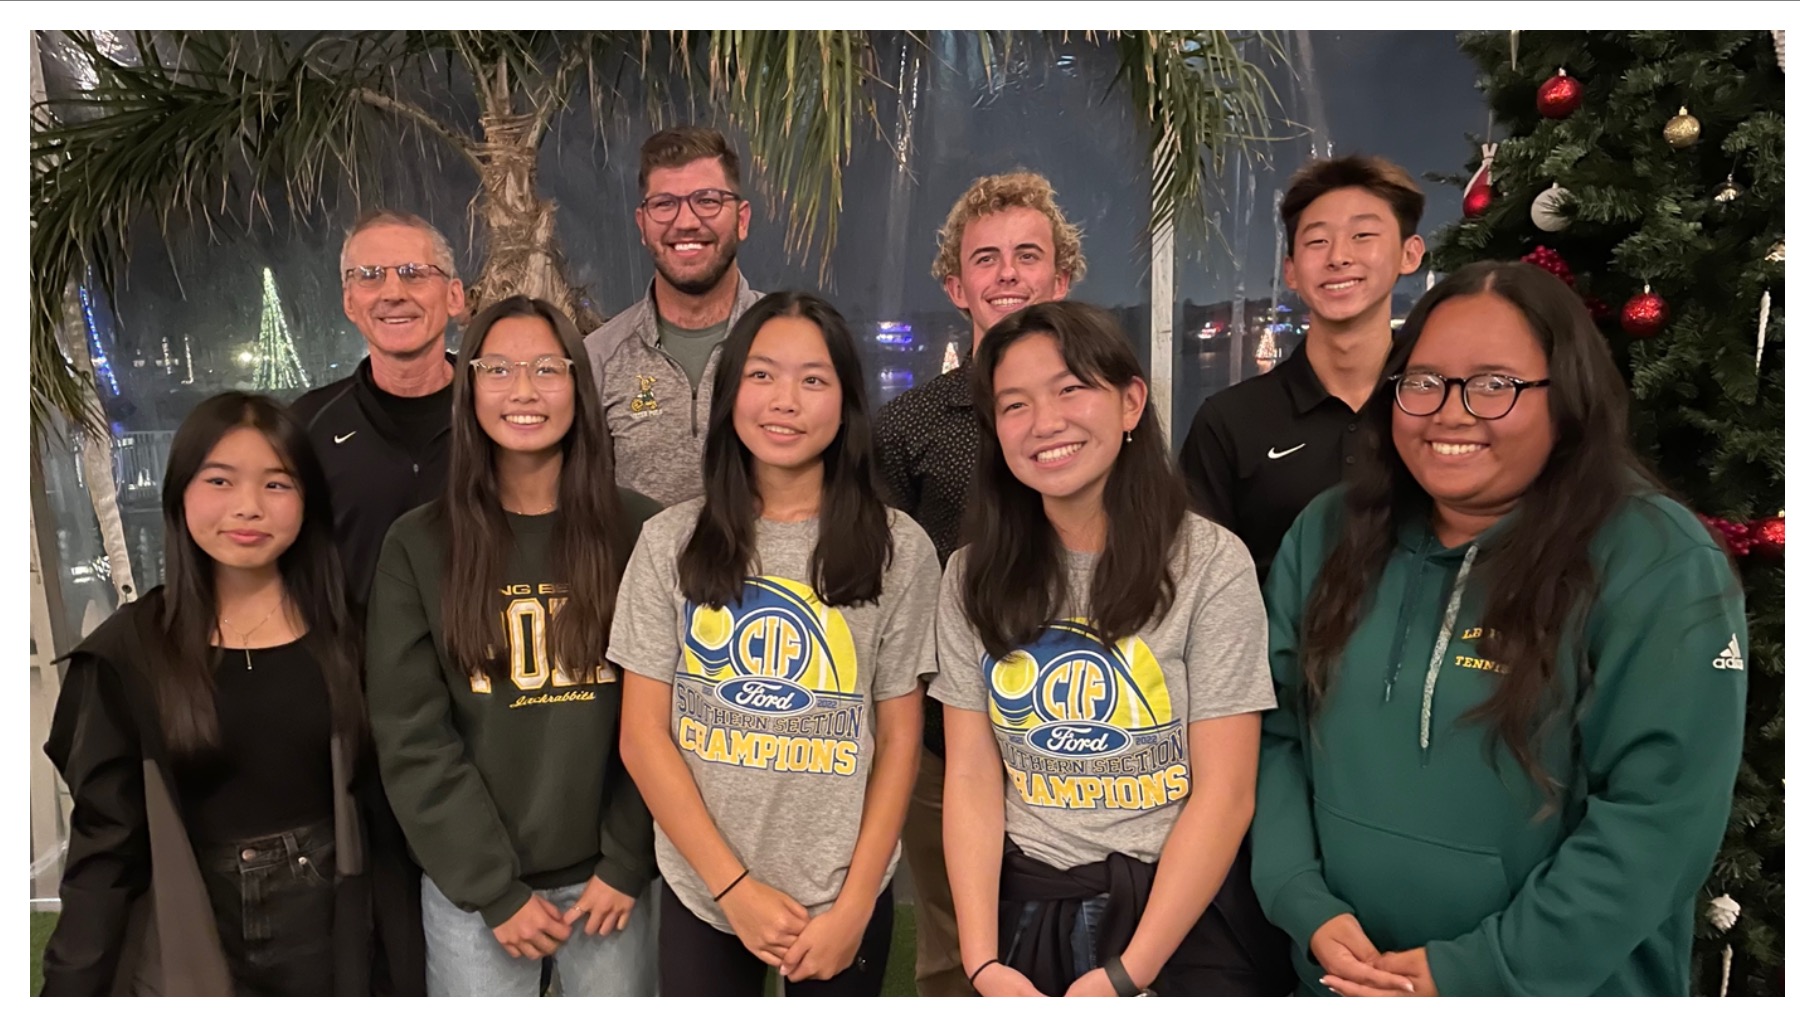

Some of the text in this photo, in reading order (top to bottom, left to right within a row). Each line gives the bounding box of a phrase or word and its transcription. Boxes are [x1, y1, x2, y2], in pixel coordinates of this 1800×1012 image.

[738, 615, 802, 680] CIF
[735, 682, 796, 711] Ford
[1042, 659, 1106, 721] CIF
[773, 704, 863, 740] SECTION
[1046, 726, 1110, 752] Ford
[1003, 728, 1185, 774] UTHERN SECTION
